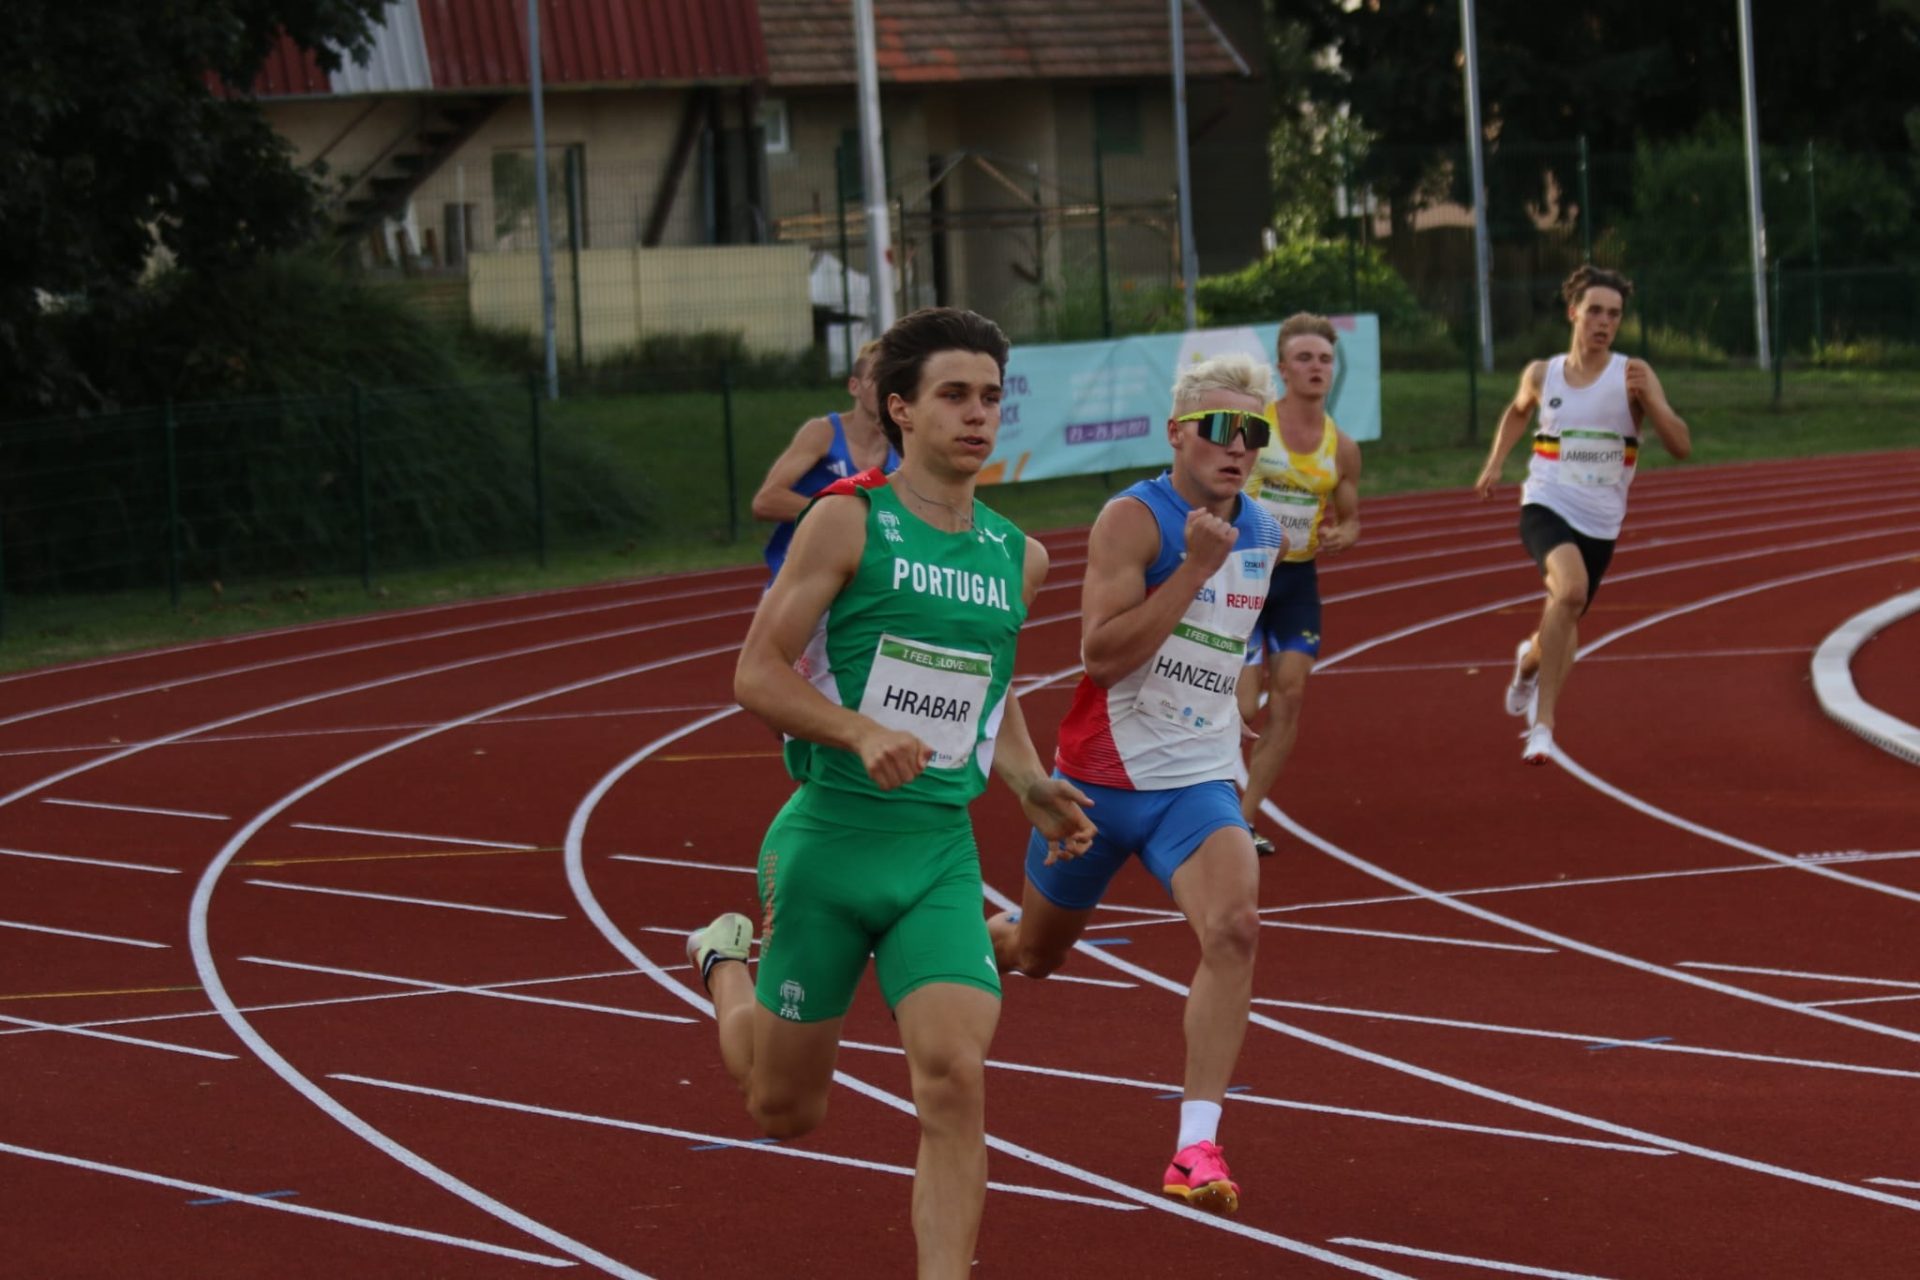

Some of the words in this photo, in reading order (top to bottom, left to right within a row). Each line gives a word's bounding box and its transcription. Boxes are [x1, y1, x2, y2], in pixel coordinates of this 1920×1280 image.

[1561, 450, 1624, 463] LAMBRECHTS
[893, 558, 1010, 611] PORTUGAL
[1195, 587, 1216, 604] ECH
[1185, 628, 1191, 638] I
[1191, 631, 1210, 644] FEEL
[903, 649, 909, 659] I
[910, 651, 934, 666] FEEL
[1154, 655, 1236, 697] HANZELKA
[882, 684, 971, 723] HRABAR
[780, 1008, 801, 1020] FPA
